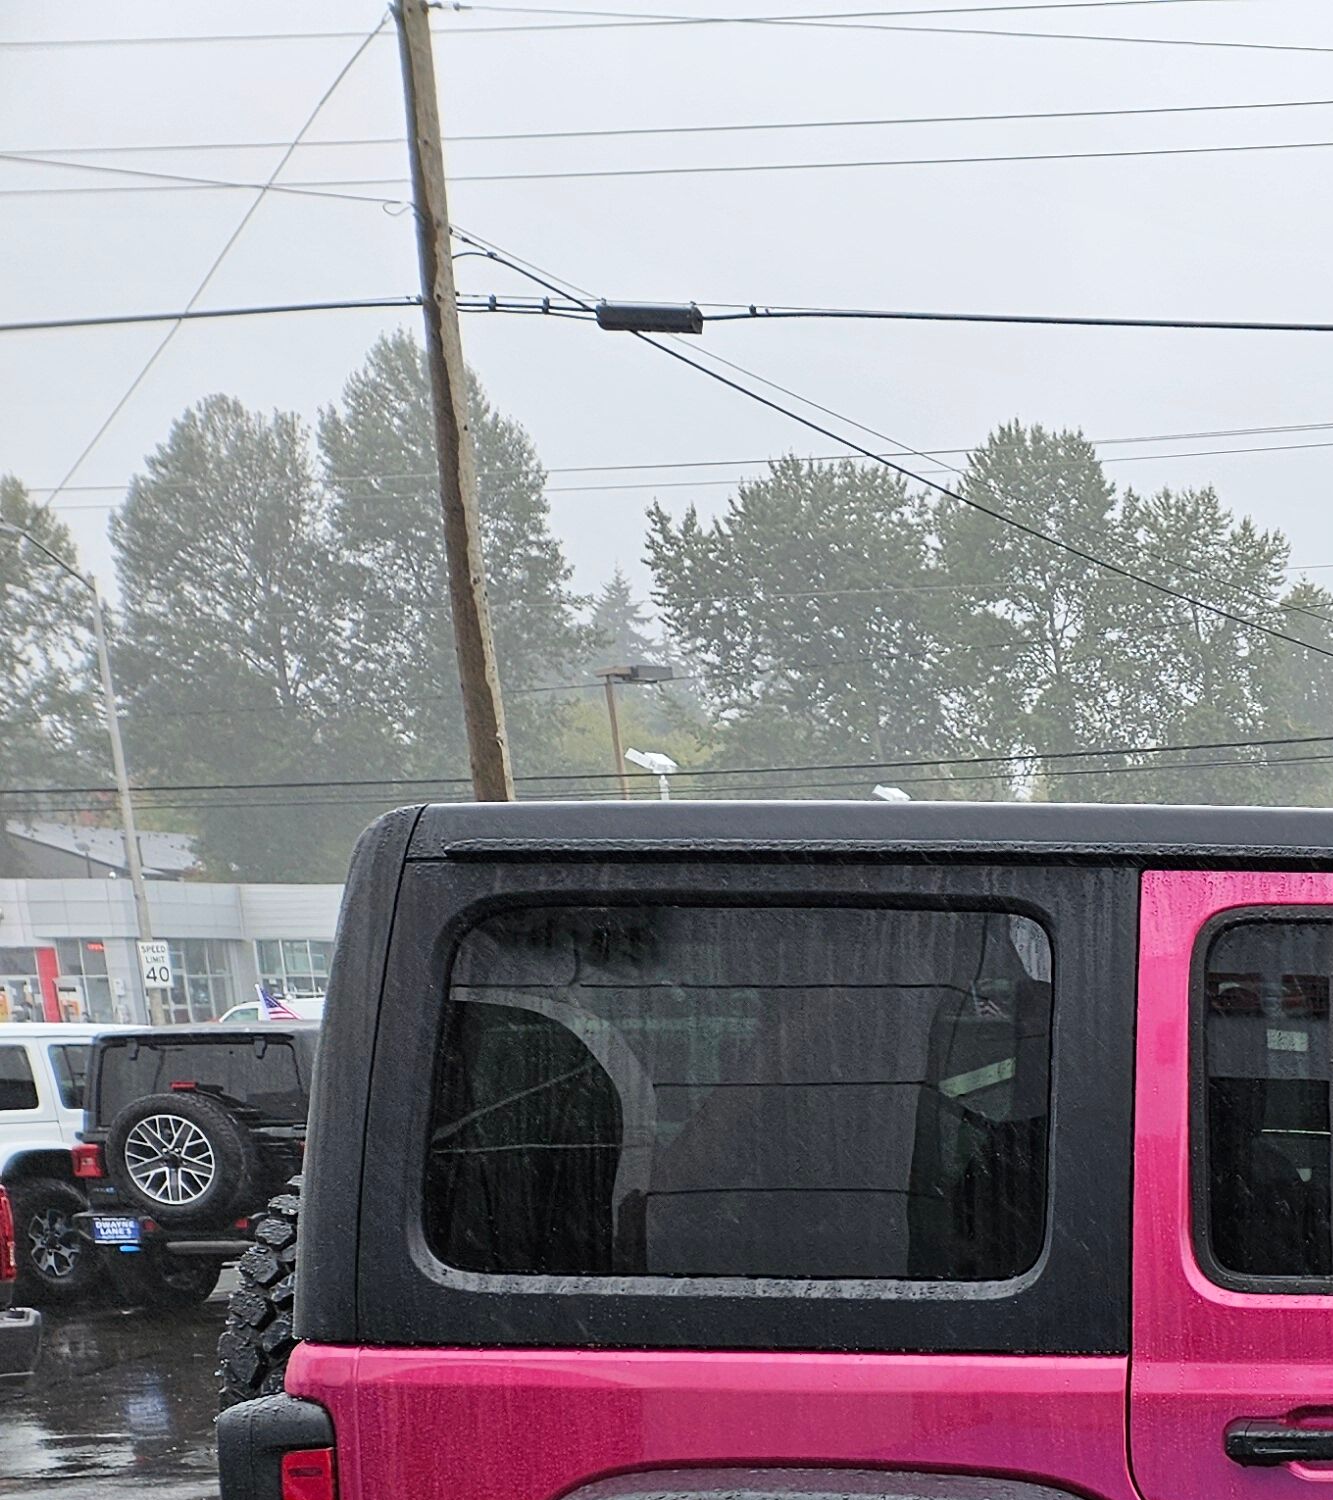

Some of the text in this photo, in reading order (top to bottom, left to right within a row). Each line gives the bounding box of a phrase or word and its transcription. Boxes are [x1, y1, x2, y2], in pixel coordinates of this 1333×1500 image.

[141, 945, 166, 953] SPEED
[145, 955, 165, 963] LIMIT
[146, 966, 170, 982] 40
[95, 1221, 135, 1229] DWAYNE
